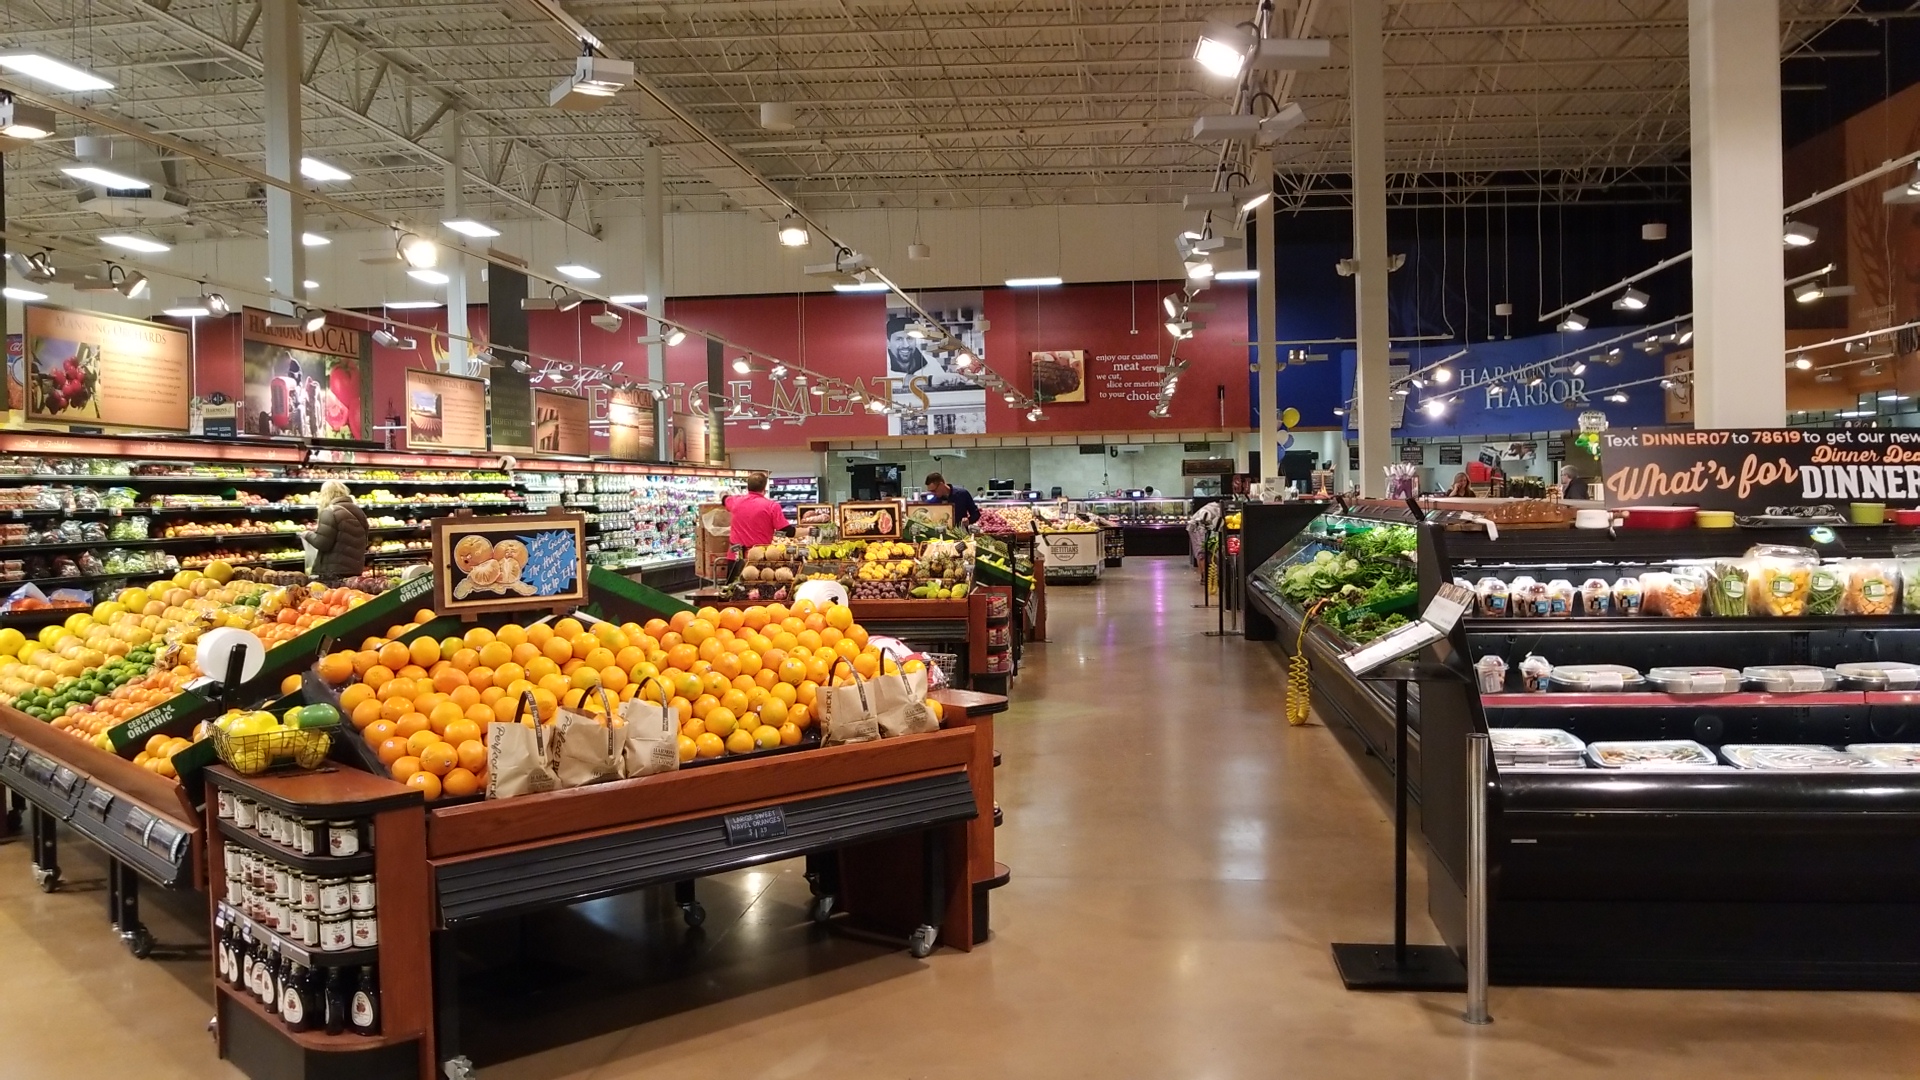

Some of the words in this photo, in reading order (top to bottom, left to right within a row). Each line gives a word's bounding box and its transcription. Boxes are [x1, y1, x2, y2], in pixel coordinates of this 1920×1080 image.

[113, 324, 167, 345] ORHARDS
[305, 327, 357, 355] LOCAL
[1096, 354, 1116, 362] enjoy
[1113, 362, 1139, 371] meat
[1106, 380, 1122, 388] slice
[1459, 361, 1557, 387] HARMONS
[772, 375, 930, 417] MEATS
[1126, 390, 1161, 401] choice
[1484, 378, 1590, 408] HARBOR
[1604, 434, 1639, 447] Text
[1642, 432, 1730, 447] DINNER07
[1732, 433, 1749, 445] to
[1751, 431, 1800, 444] 78619
[1802, 431, 1820, 444] to
[1826, 431, 1854, 446] get
[1858, 432, 1885, 444] our
[1890, 432, 1920, 443] new
[1811, 445, 1880, 464] Dinner
[1607, 459, 1735, 501] What's
[1738, 453, 1798, 499] for
[1800, 465, 1920, 500] DINNER
[529, 564, 540, 578] The
[543, 541, 571, 568] Humans
[400, 576, 427, 593] CERTIFIED
[541, 577, 559, 595] Help
[561, 559, 575, 582] It!
[127, 708, 161, 729] CERTIFIED
[127, 711, 172, 739] ORGANIC
[553, 716, 573, 758] Perfect
[491, 726, 505, 770] Perfect
[731, 822, 751, 830] NAVEL
[753, 816, 781, 827] ORANGES
[732, 815, 753, 824] LARGE
[755, 810, 776, 820] SWEET
